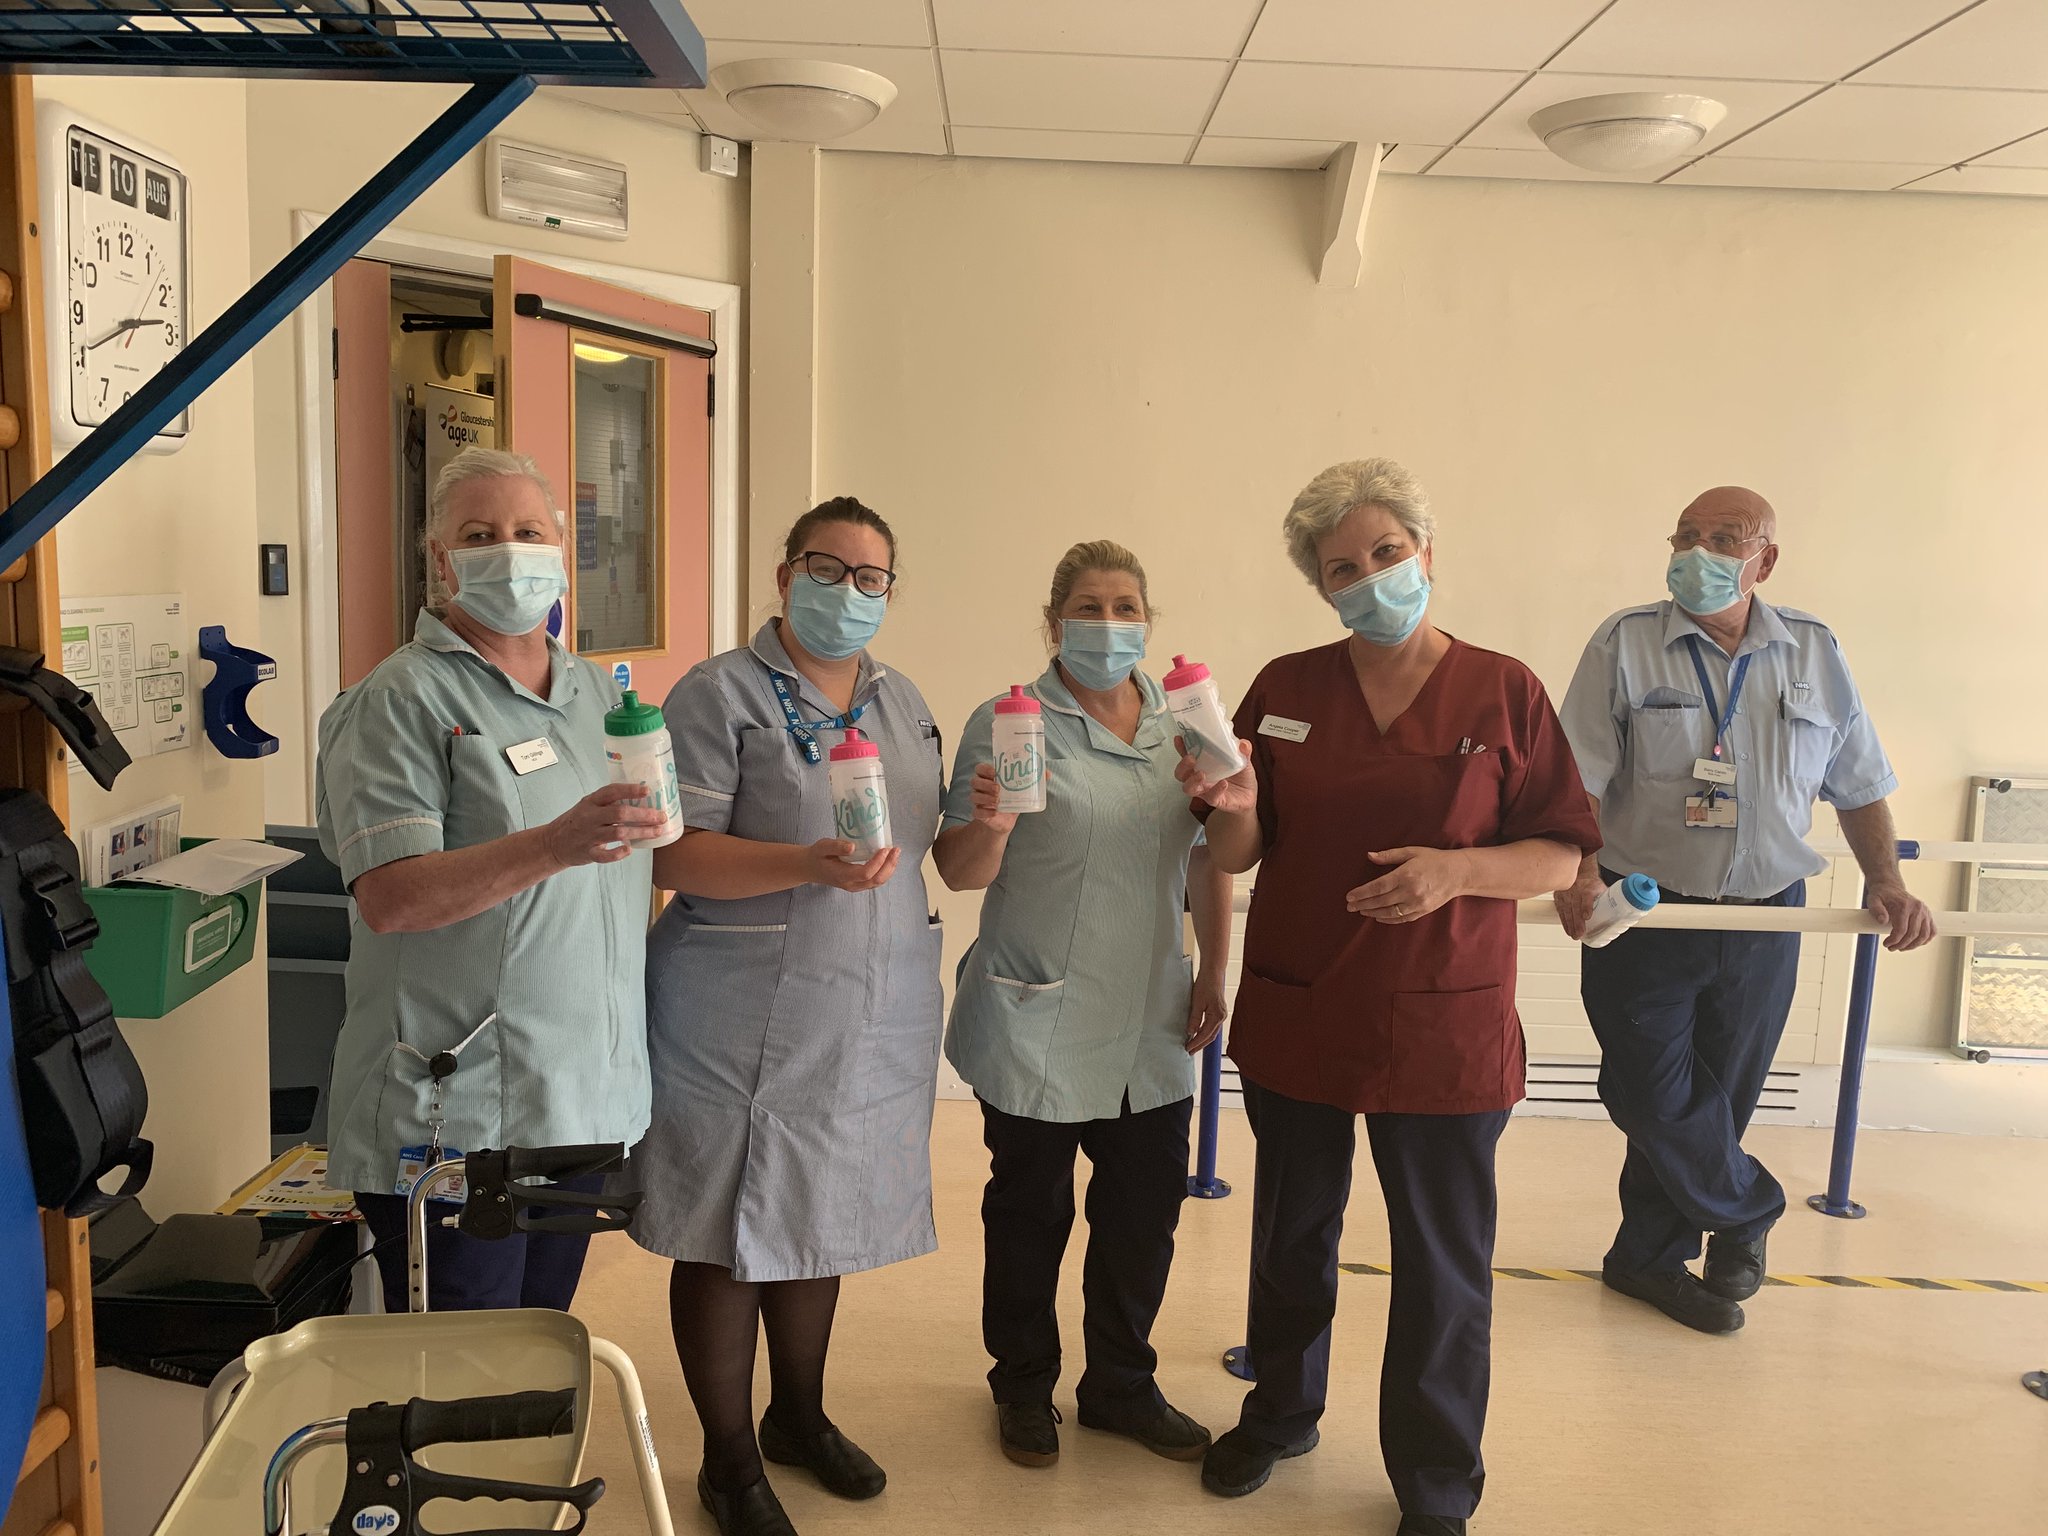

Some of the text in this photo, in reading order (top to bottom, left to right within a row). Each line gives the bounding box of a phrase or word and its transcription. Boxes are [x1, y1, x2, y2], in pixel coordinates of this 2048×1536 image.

[71, 146, 167, 206] TUE 10 AUG
[96, 235, 110, 262] 11
[118, 232, 134, 258] 12
[145, 252, 151, 275] 1
[159, 284, 168, 307] 2
[73, 300, 83, 325] 9
[164, 323, 174, 346] 3
[100, 377, 110, 401] 7
[258, 667, 275, 676] ECOLAB
[774, 679, 787, 694] NHS
[1794, 682, 1810, 690] NHS
[782, 698, 796, 714] NHS
[792, 727, 810, 741] NHS
[808, 741, 820, 761] NHS
[356, 1511, 395, 1531] days
